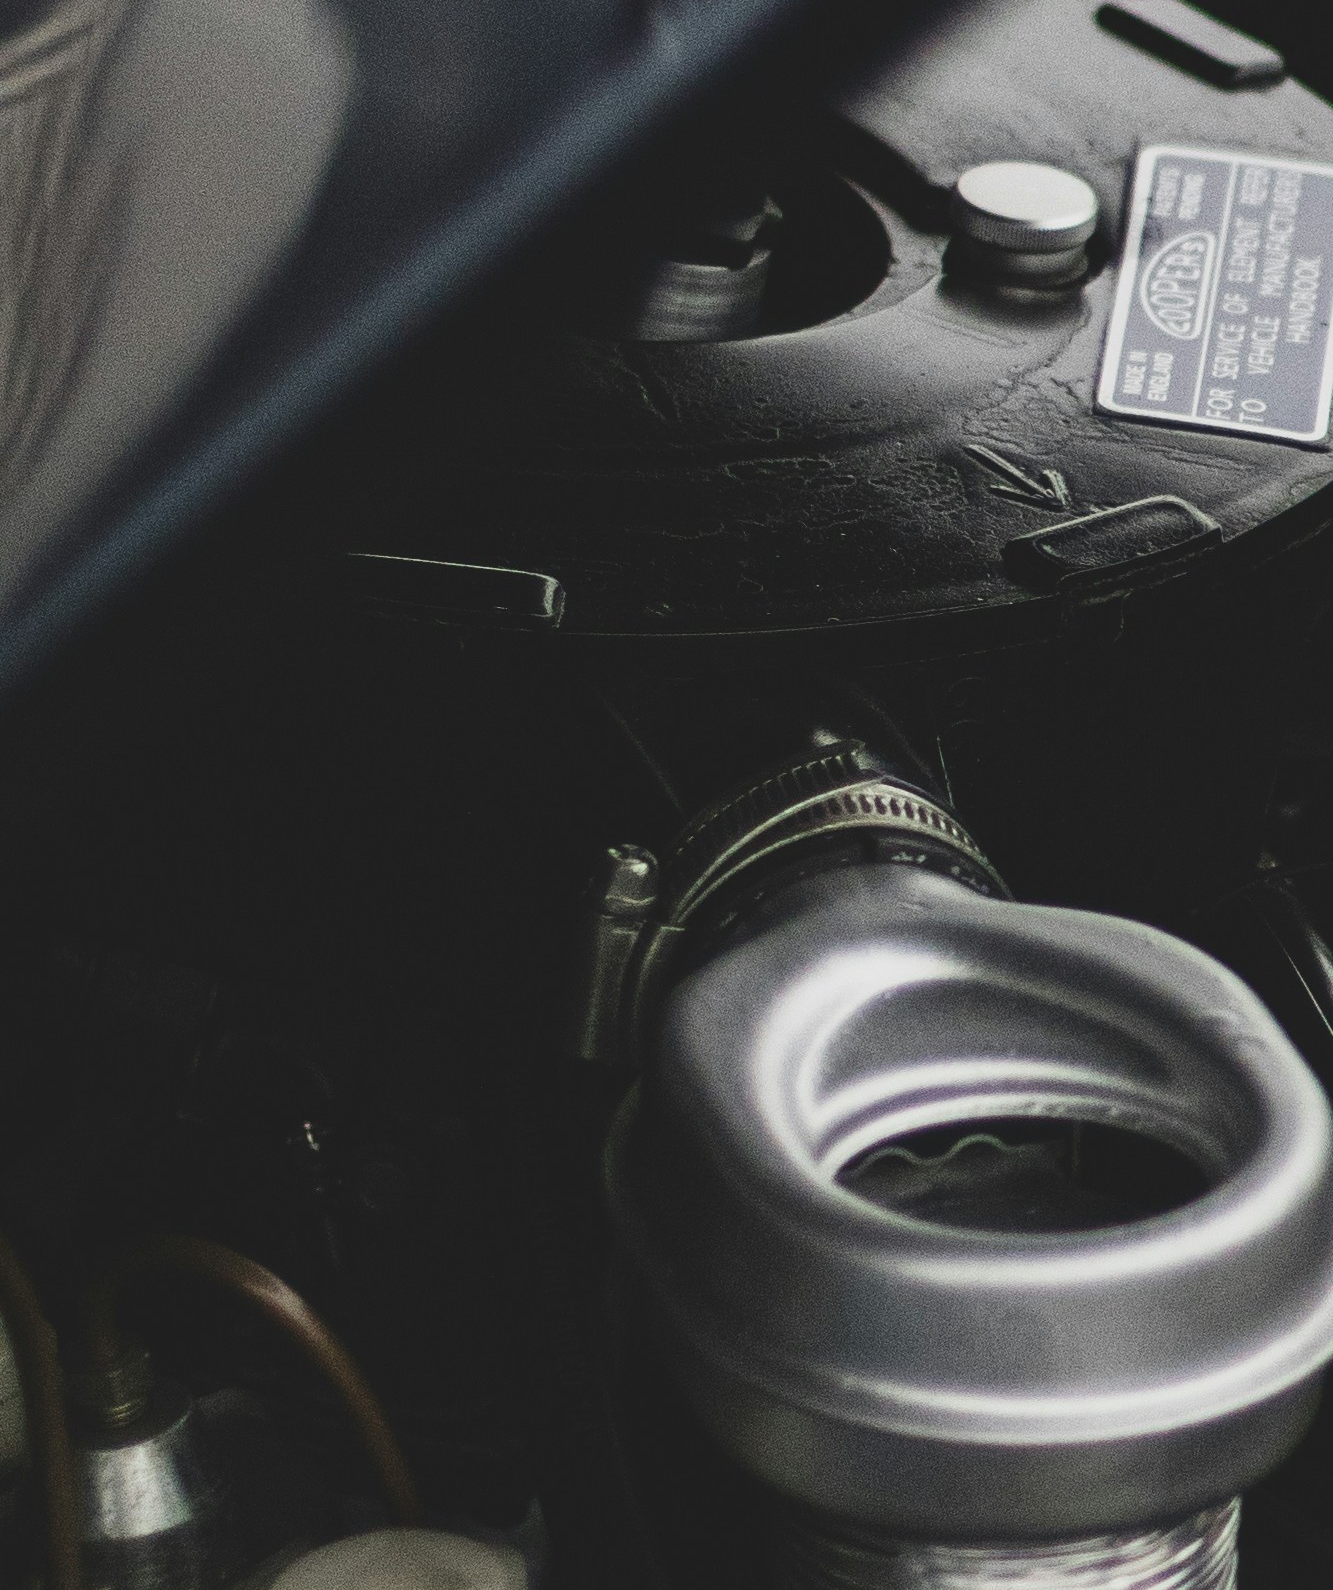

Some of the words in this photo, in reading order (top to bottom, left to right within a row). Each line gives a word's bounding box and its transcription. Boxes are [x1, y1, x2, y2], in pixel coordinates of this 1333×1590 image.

[1228, 216, 1262, 285] ELEMENT
[1148, 239, 1206, 333] COOPERS
[1222, 292, 1251, 317] OF
[1128, 349, 1149, 363] IN
[1211, 322, 1245, 381] SERVICE
[1246, 314, 1280, 378] VEHICLE
[1122, 364, 1146, 396] MADE
[1148, 351, 1175, 402] ENGLAND
[1205, 387, 1235, 421] FOR
[1237, 397, 1267, 426] TO
